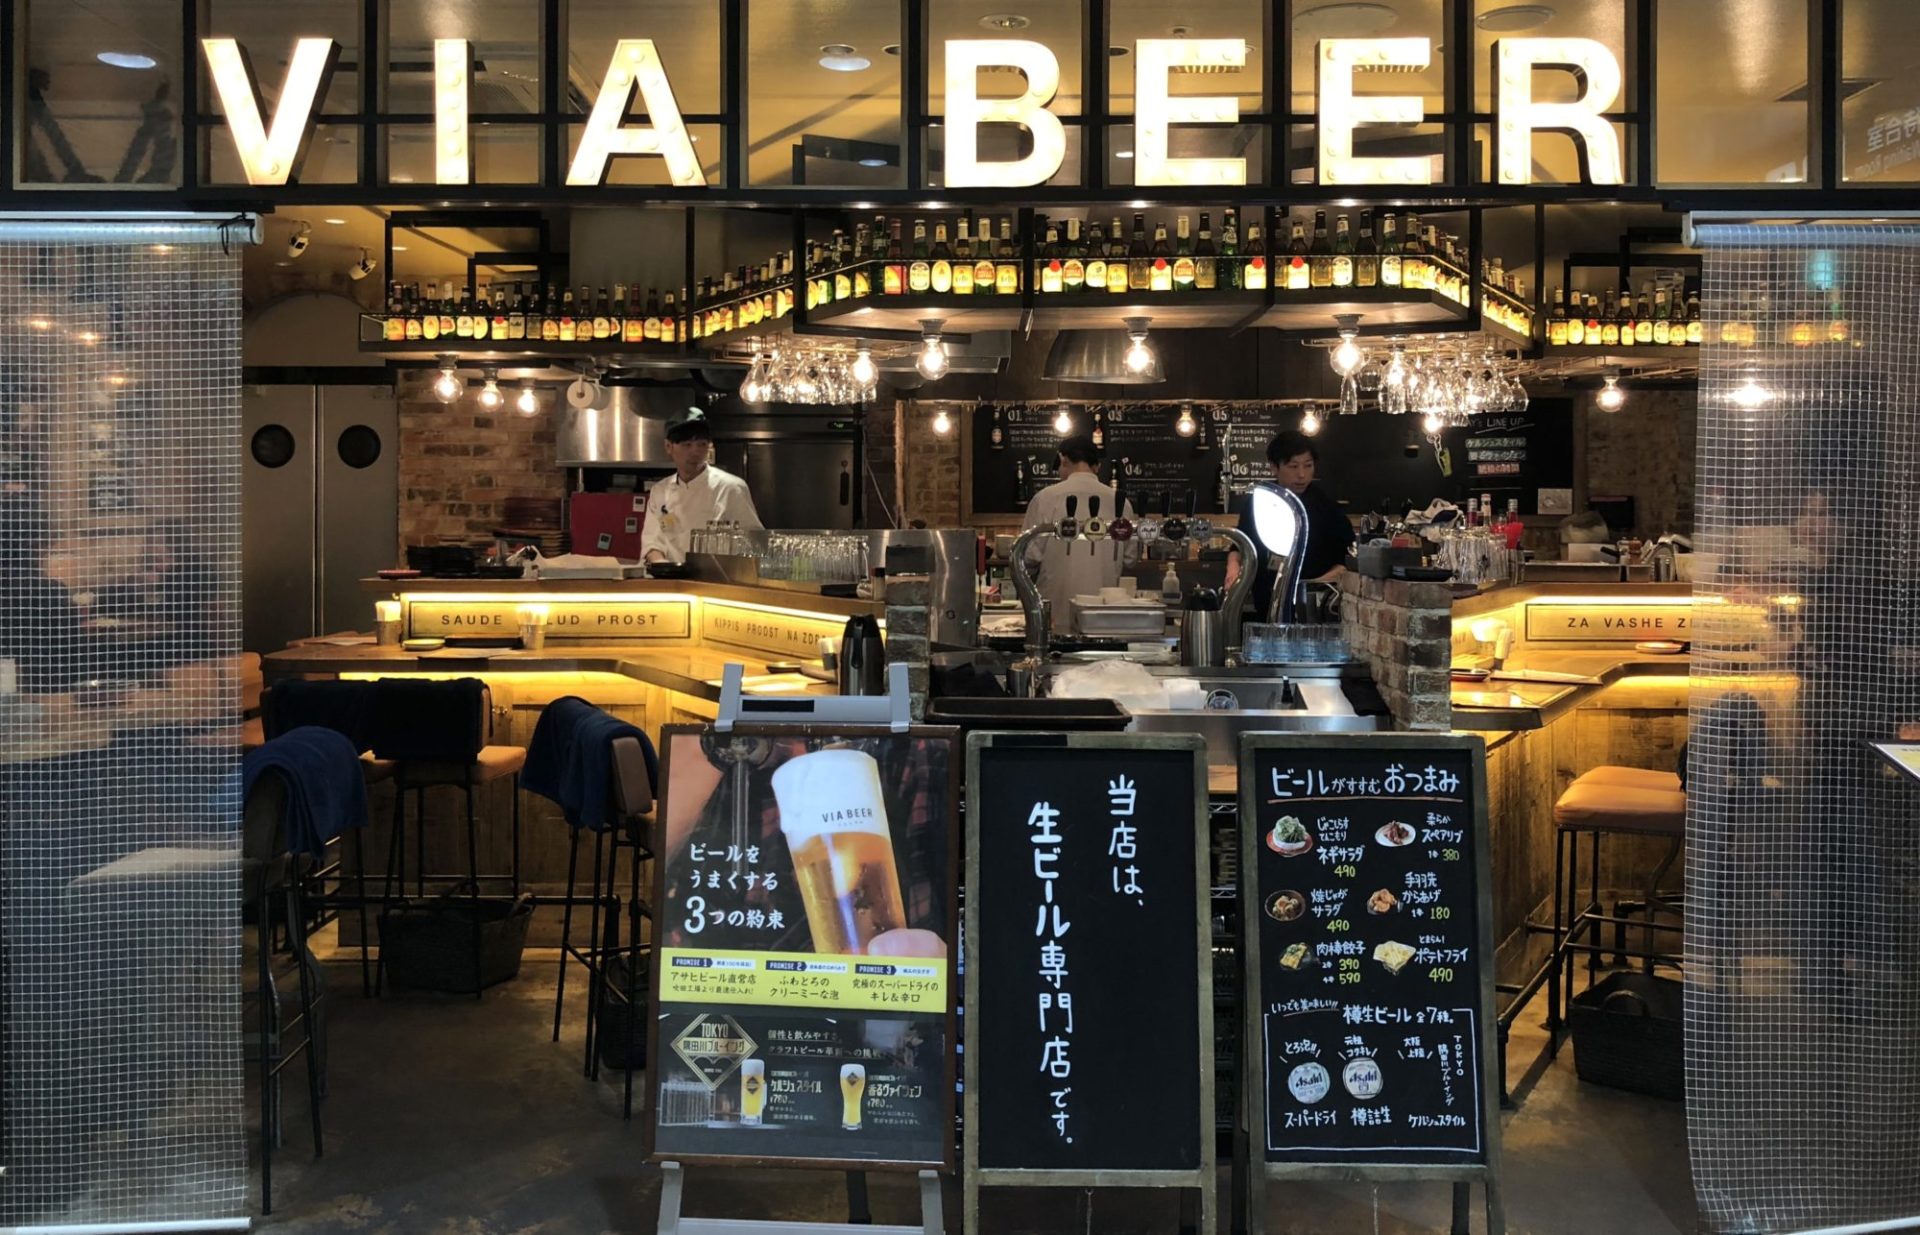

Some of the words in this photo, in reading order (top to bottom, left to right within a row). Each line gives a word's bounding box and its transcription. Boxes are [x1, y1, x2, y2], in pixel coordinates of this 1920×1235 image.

[202, 38, 707, 187] VIA
[943, 37, 1626, 188] BEER
[441, 614, 502, 626] SAUDE
[597, 614, 659, 626] PROST
[1567, 617, 1589, 628] ZA
[1603, 617, 1664, 628] VASHE
[714, 617, 740, 633] KIPPIS
[746, 622, 779, 639] PROOST
[787, 630, 798, 641] NA
[1271, 763, 1460, 797] ビールがすすむおつまみ
[822, 810, 844, 823] VIA
[846, 808, 872, 819] BEER
[1107, 774, 1143, 906] 当店は、
[1421, 828, 1463, 843] スペアリブ
[690, 843, 760, 864] ビールを
[1316, 844, 1366, 865] ネギサラダ
[1442, 848, 1460, 861] 380
[1334, 865, 1356, 877] 490
[690, 869, 778, 891] うまくする
[1404, 871, 1438, 888] 手羽先
[1402, 889, 1442, 904] からあげ
[684, 895, 786, 934] 3つの約束
[1311, 902, 1344, 918] サラダ
[1430, 906, 1451, 920] 180
[1326, 919, 1350, 933] 490
[675, 958, 701, 966] PROMISE
[1414, 947, 1469, 964] ポテトフライ
[769, 961, 795, 970] PROMISE
[858, 965, 884, 974] PROMISE
[1338, 958, 1360, 971] 390
[671, 972, 757, 985] アサヒビール直営店
[1027, 801, 1074, 1144] 生ビール専門店です。
[1338, 972, 1361, 984] 590
[1428, 967, 1453, 983] 490
[779, 975, 830, 987] ふわとろの
[852, 978, 939, 991] 究極のスーパードライの
[769, 987, 839, 1001] クリーミーな泡
[1342, 1004, 1412, 1025] 樽生ビール
[701, 1023, 729, 1038] TOKYO
[1453, 1035, 1464, 1076] TOKYO
[1295, 1071, 1323, 1088] Asahi
[1349, 1070, 1378, 1083] Asahi
[1284, 1109, 1337, 1128] スーパードライ
